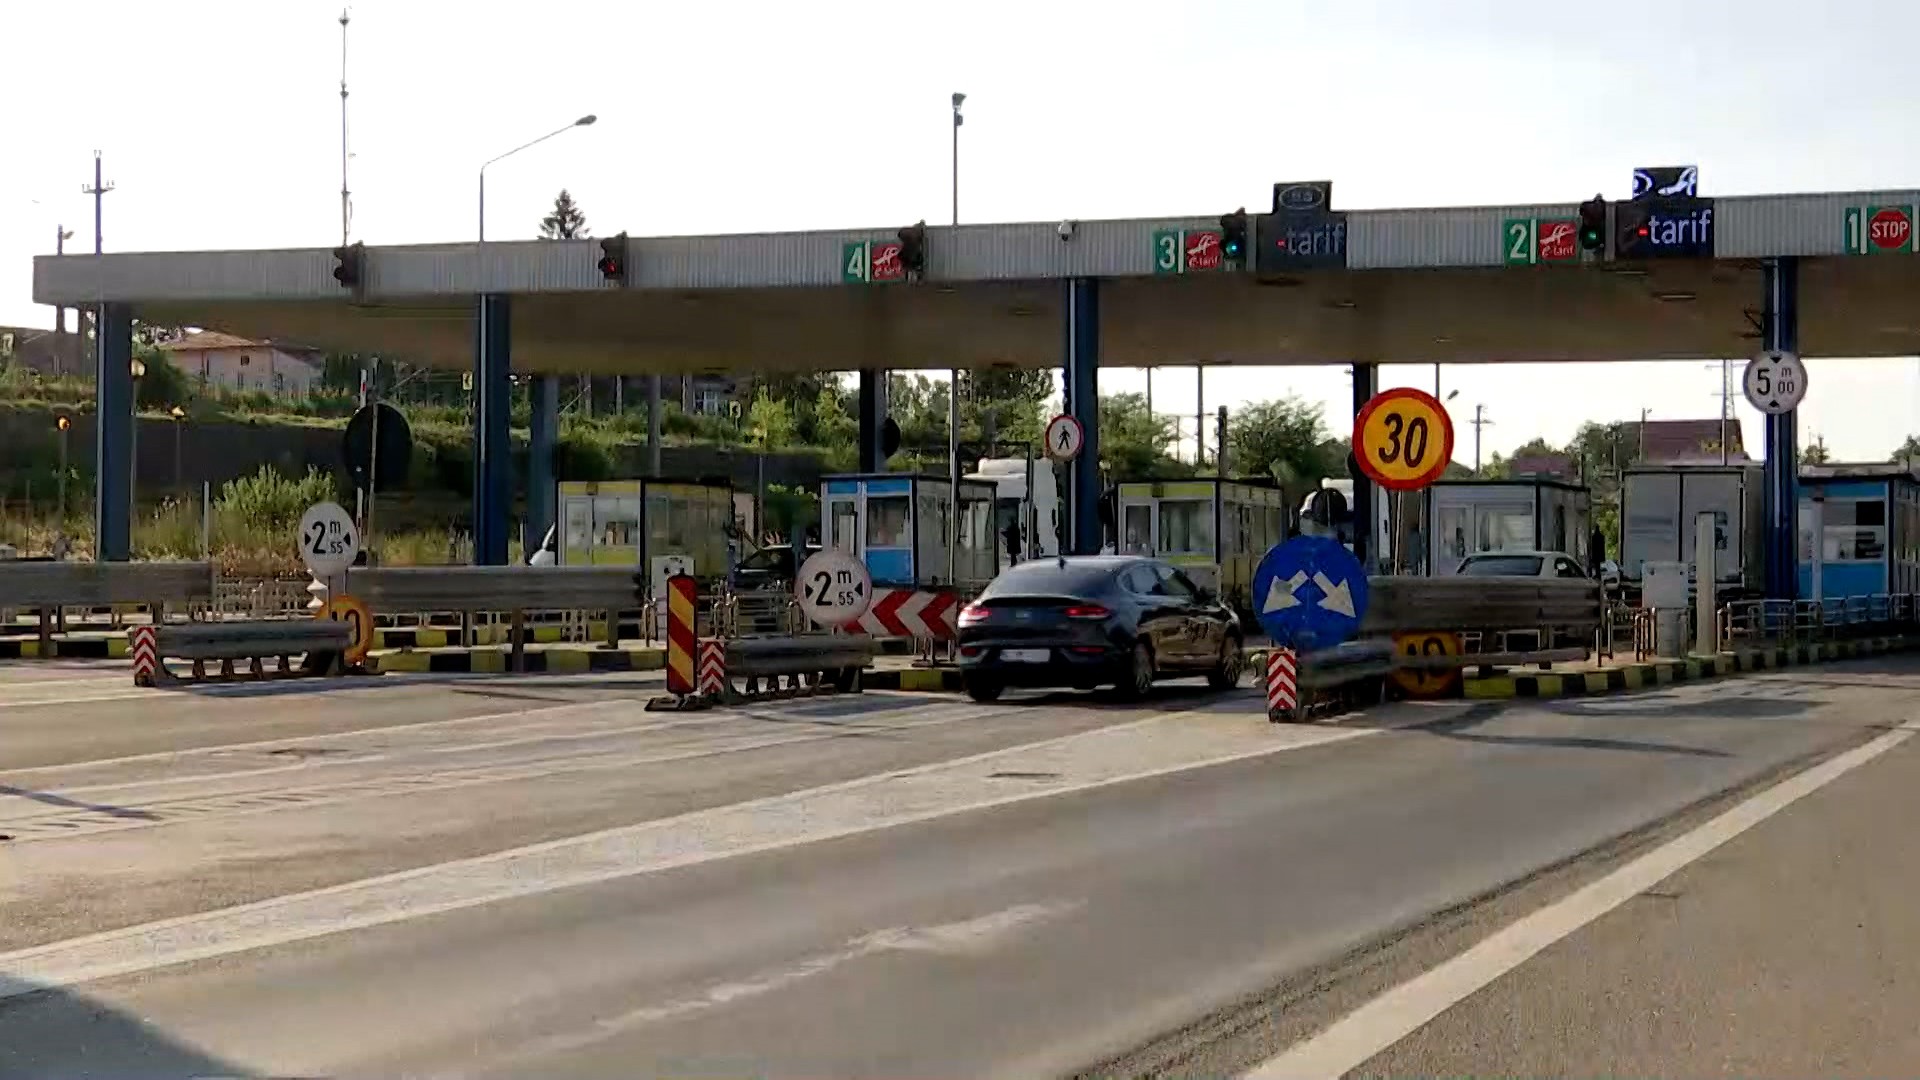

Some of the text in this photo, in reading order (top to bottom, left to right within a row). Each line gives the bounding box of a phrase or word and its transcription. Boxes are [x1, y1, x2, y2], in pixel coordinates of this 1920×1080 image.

[1509, 223, 1528, 258] 2
[1848, 213, 1858, 248] 1
[1871, 221, 1908, 238] STOP
[847, 247, 864, 278] 4
[1159, 235, 1176, 270] 3
[1757, 367, 1792, 396] 5 m
[1777, 381, 1795, 394] 00
[1378, 412, 1428, 469] 30
[312, 520, 341, 554] 2 m
[330, 541, 344, 554] 55
[814, 570, 852, 606] 2 m
